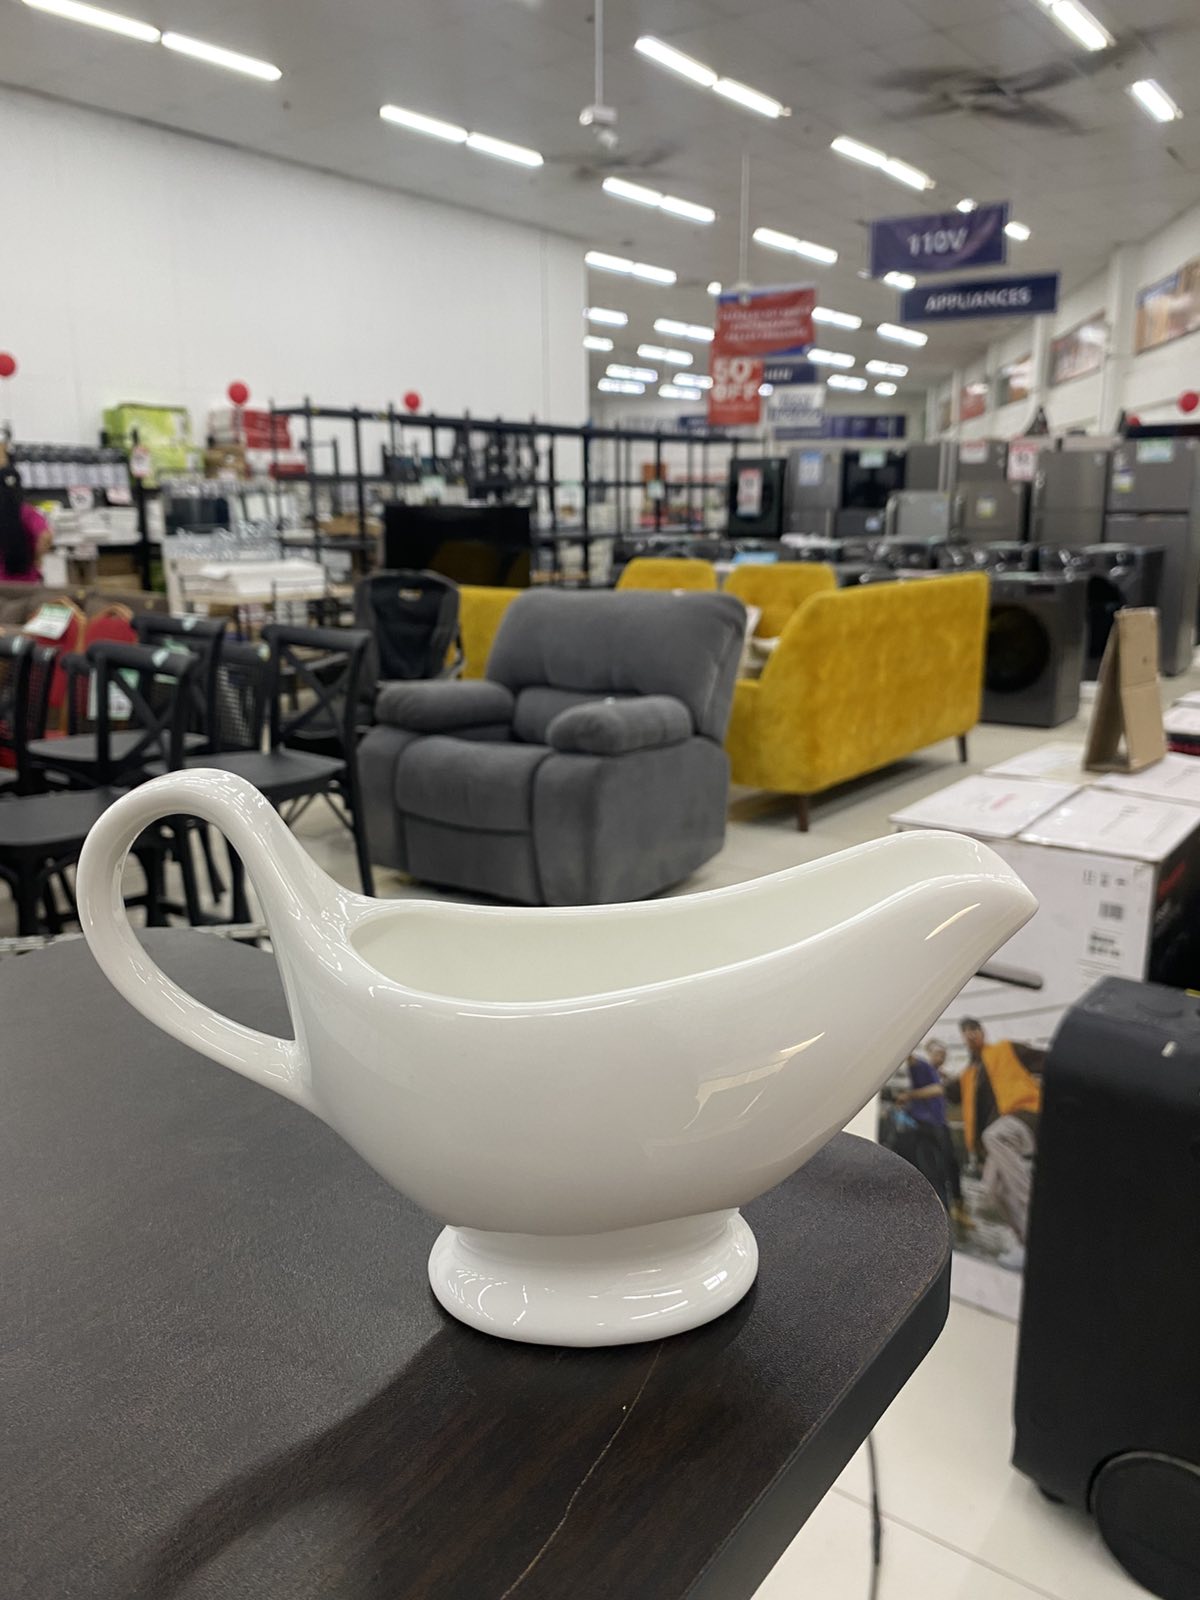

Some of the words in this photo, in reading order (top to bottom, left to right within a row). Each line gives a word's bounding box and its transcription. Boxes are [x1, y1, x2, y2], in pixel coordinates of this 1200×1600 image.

[908, 227, 969, 256] 110V
[924, 286, 1033, 313] APPLIANCES
[712, 382, 758, 402] OFF
